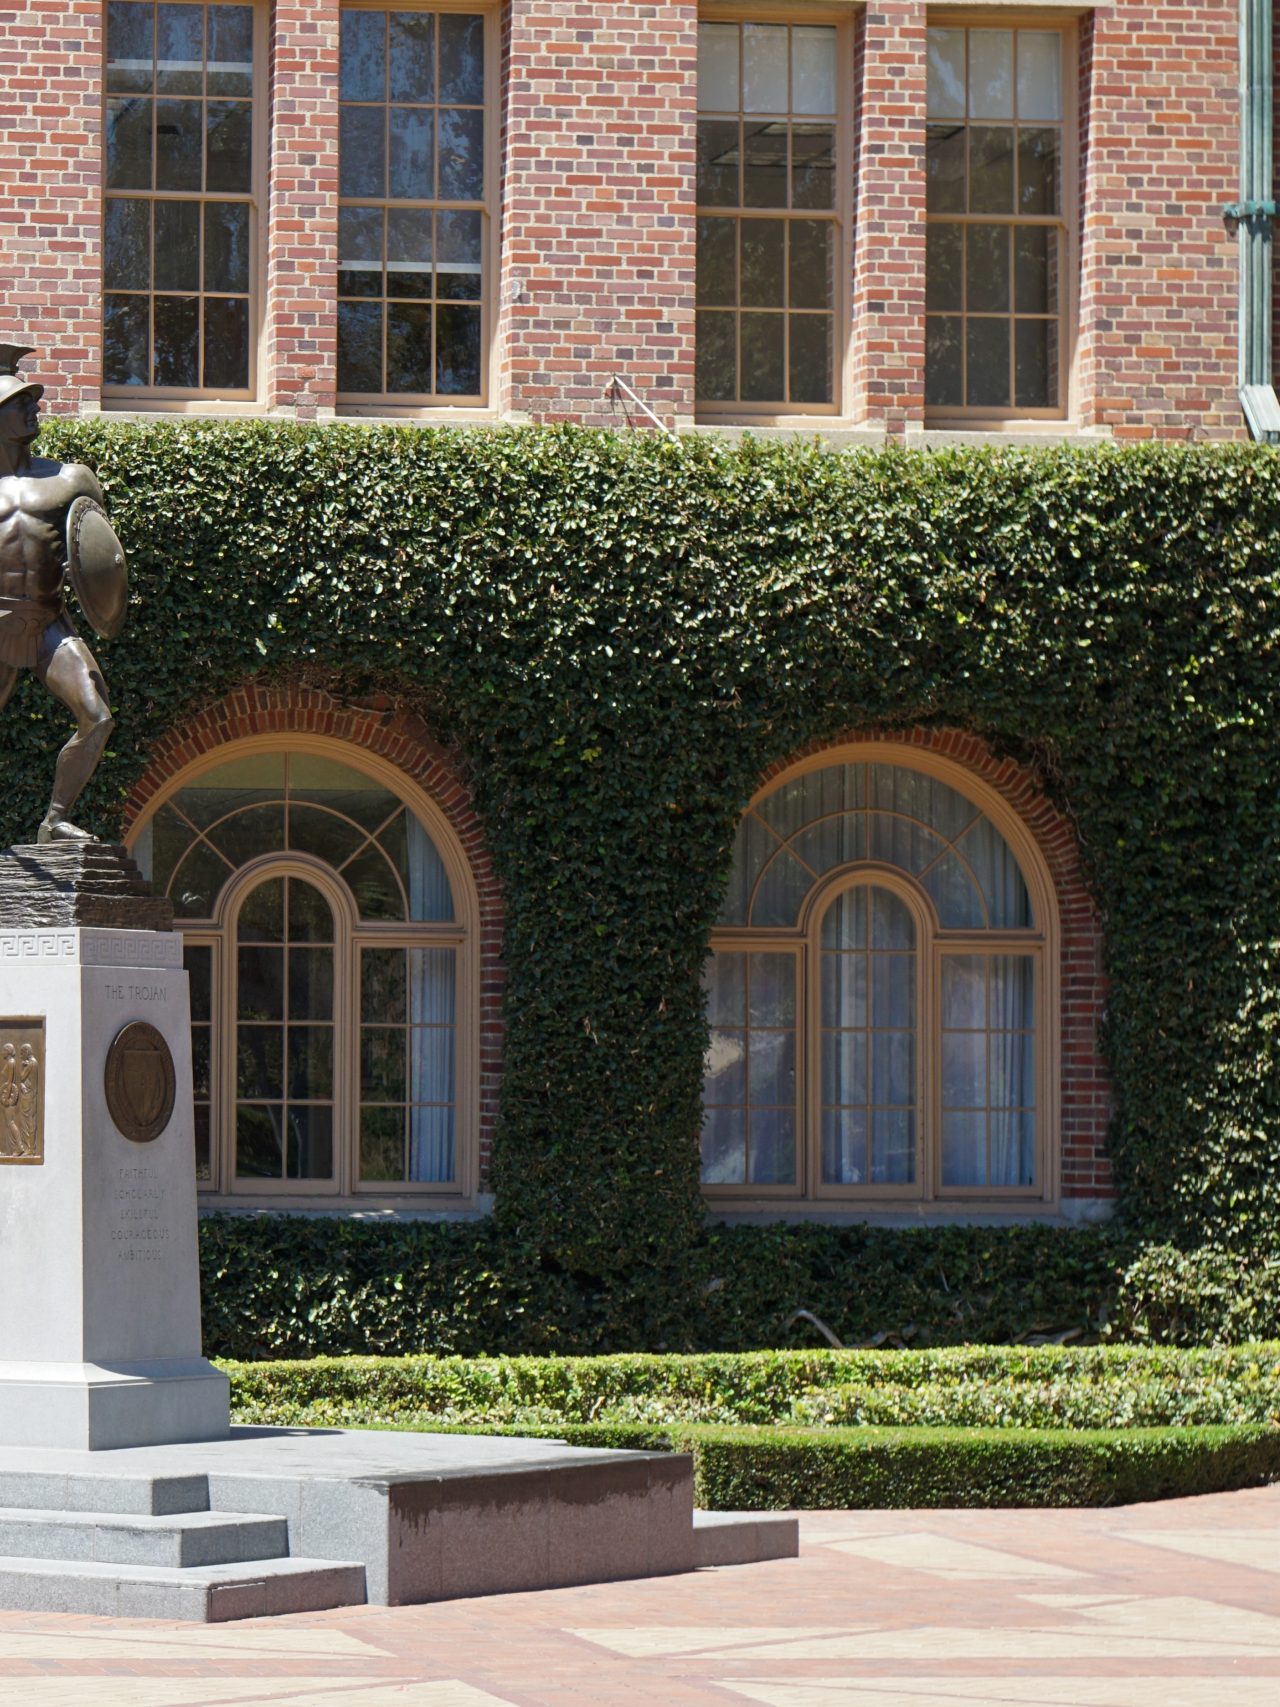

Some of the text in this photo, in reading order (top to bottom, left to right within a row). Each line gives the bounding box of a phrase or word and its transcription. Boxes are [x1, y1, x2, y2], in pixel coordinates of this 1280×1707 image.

[104, 984, 167, 1001] THE TROJAN
[119, 1167, 159, 1180] FAITHFUL
[113, 1188, 166, 1200] SCHOLARLY
[120, 1208, 159, 1220] SKILLFUL
[111, 1228, 169, 1240] COURAGEOUS
[118, 1248, 161, 1260] AMBITIOUS
